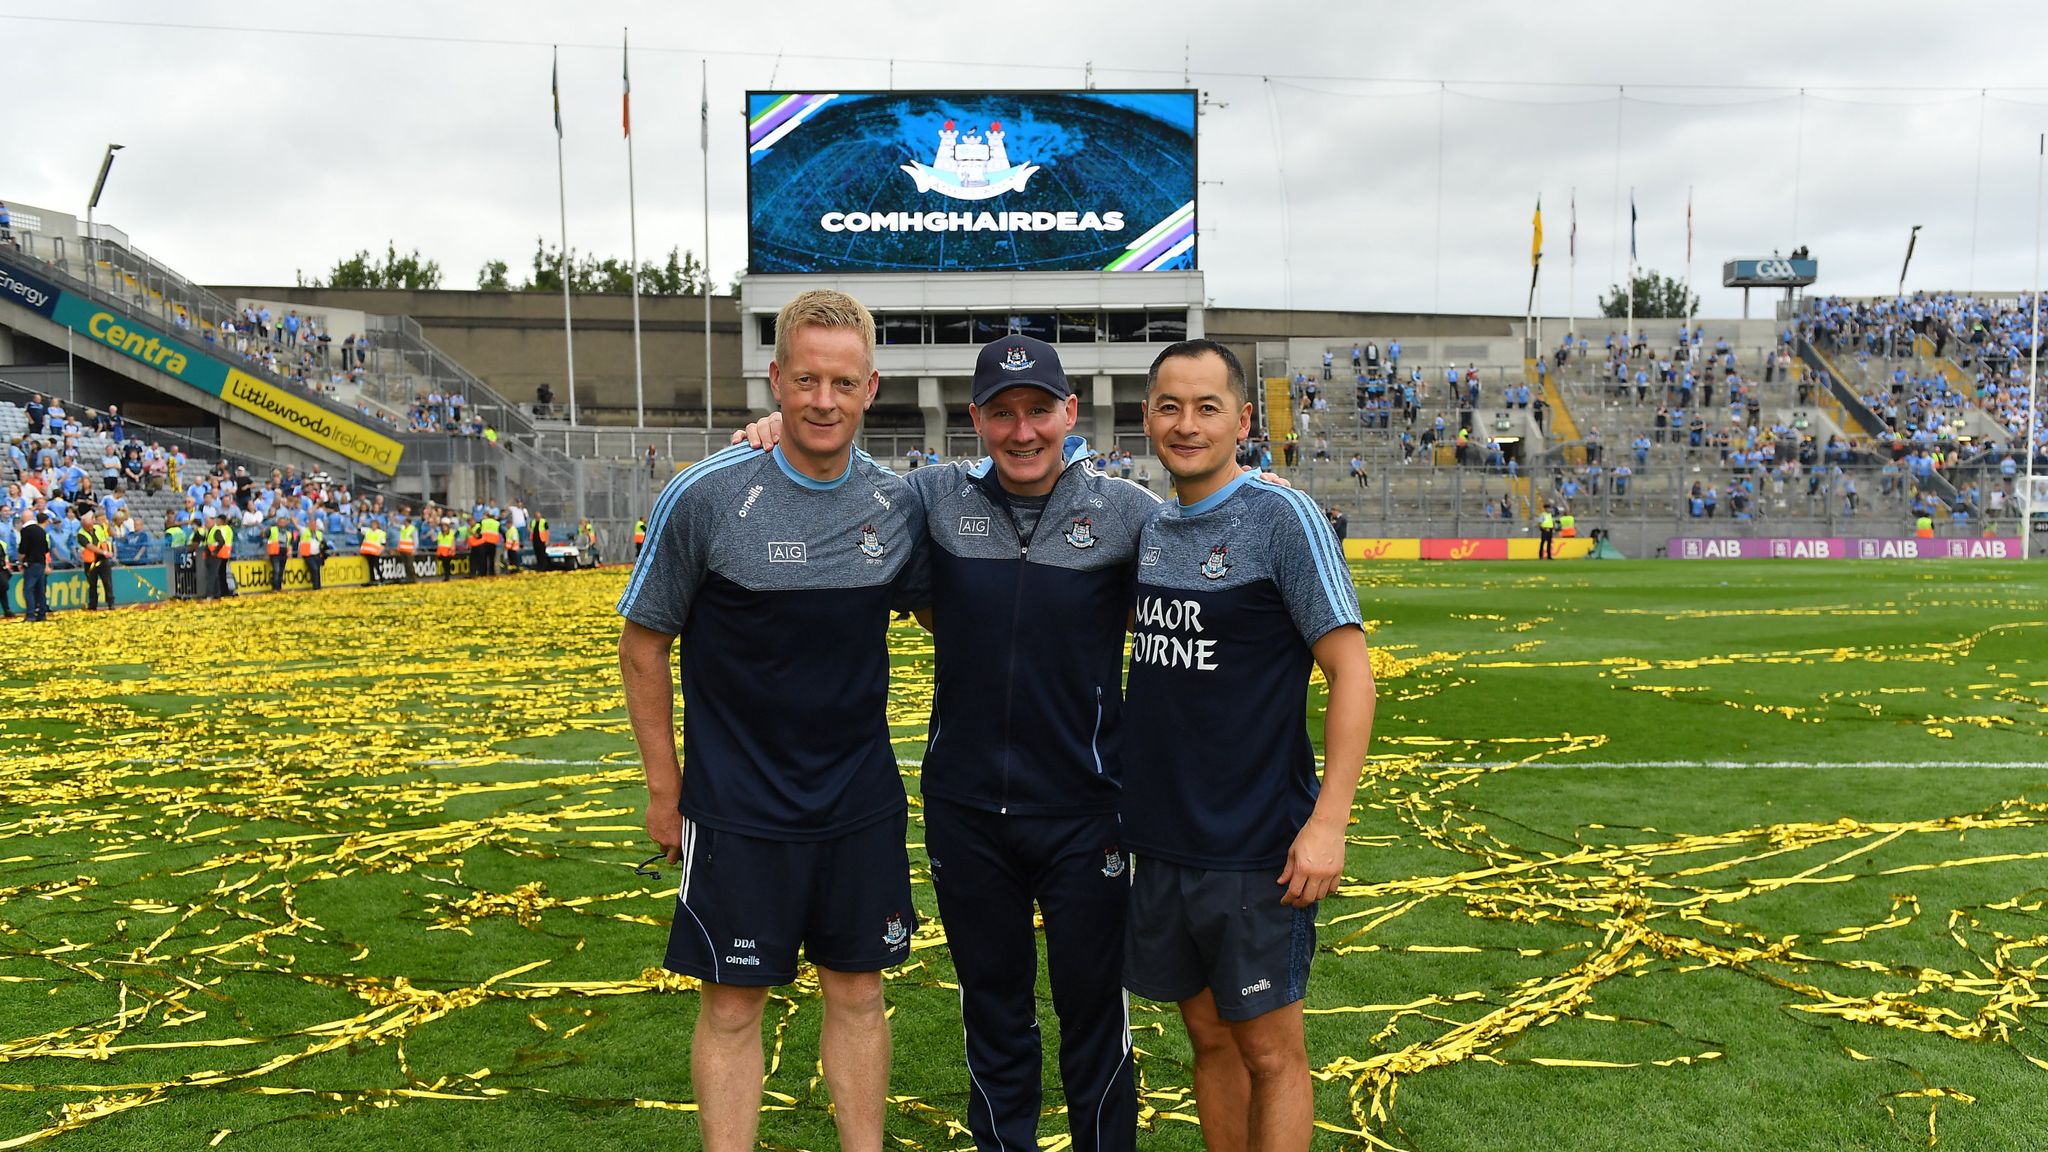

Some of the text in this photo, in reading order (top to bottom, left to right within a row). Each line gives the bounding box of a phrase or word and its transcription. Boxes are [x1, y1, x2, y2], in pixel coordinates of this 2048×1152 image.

[820, 211, 1125, 232] COMHGHAIRDEAS
[1756, 260, 1796, 279] GAA
[88, 312, 188, 375] Centra
[873, 490, 891, 511] DDA
[962, 520, 986, 532] AIG
[773, 546, 802, 559] AIG
[1704, 540, 1742, 558] AIB
[1793, 540, 1830, 558] AIB
[1881, 540, 1919, 558] AIB
[1970, 540, 2007, 558] AIB
[1135, 595, 1204, 633] MAOR
[734, 938, 756, 949] DDA
